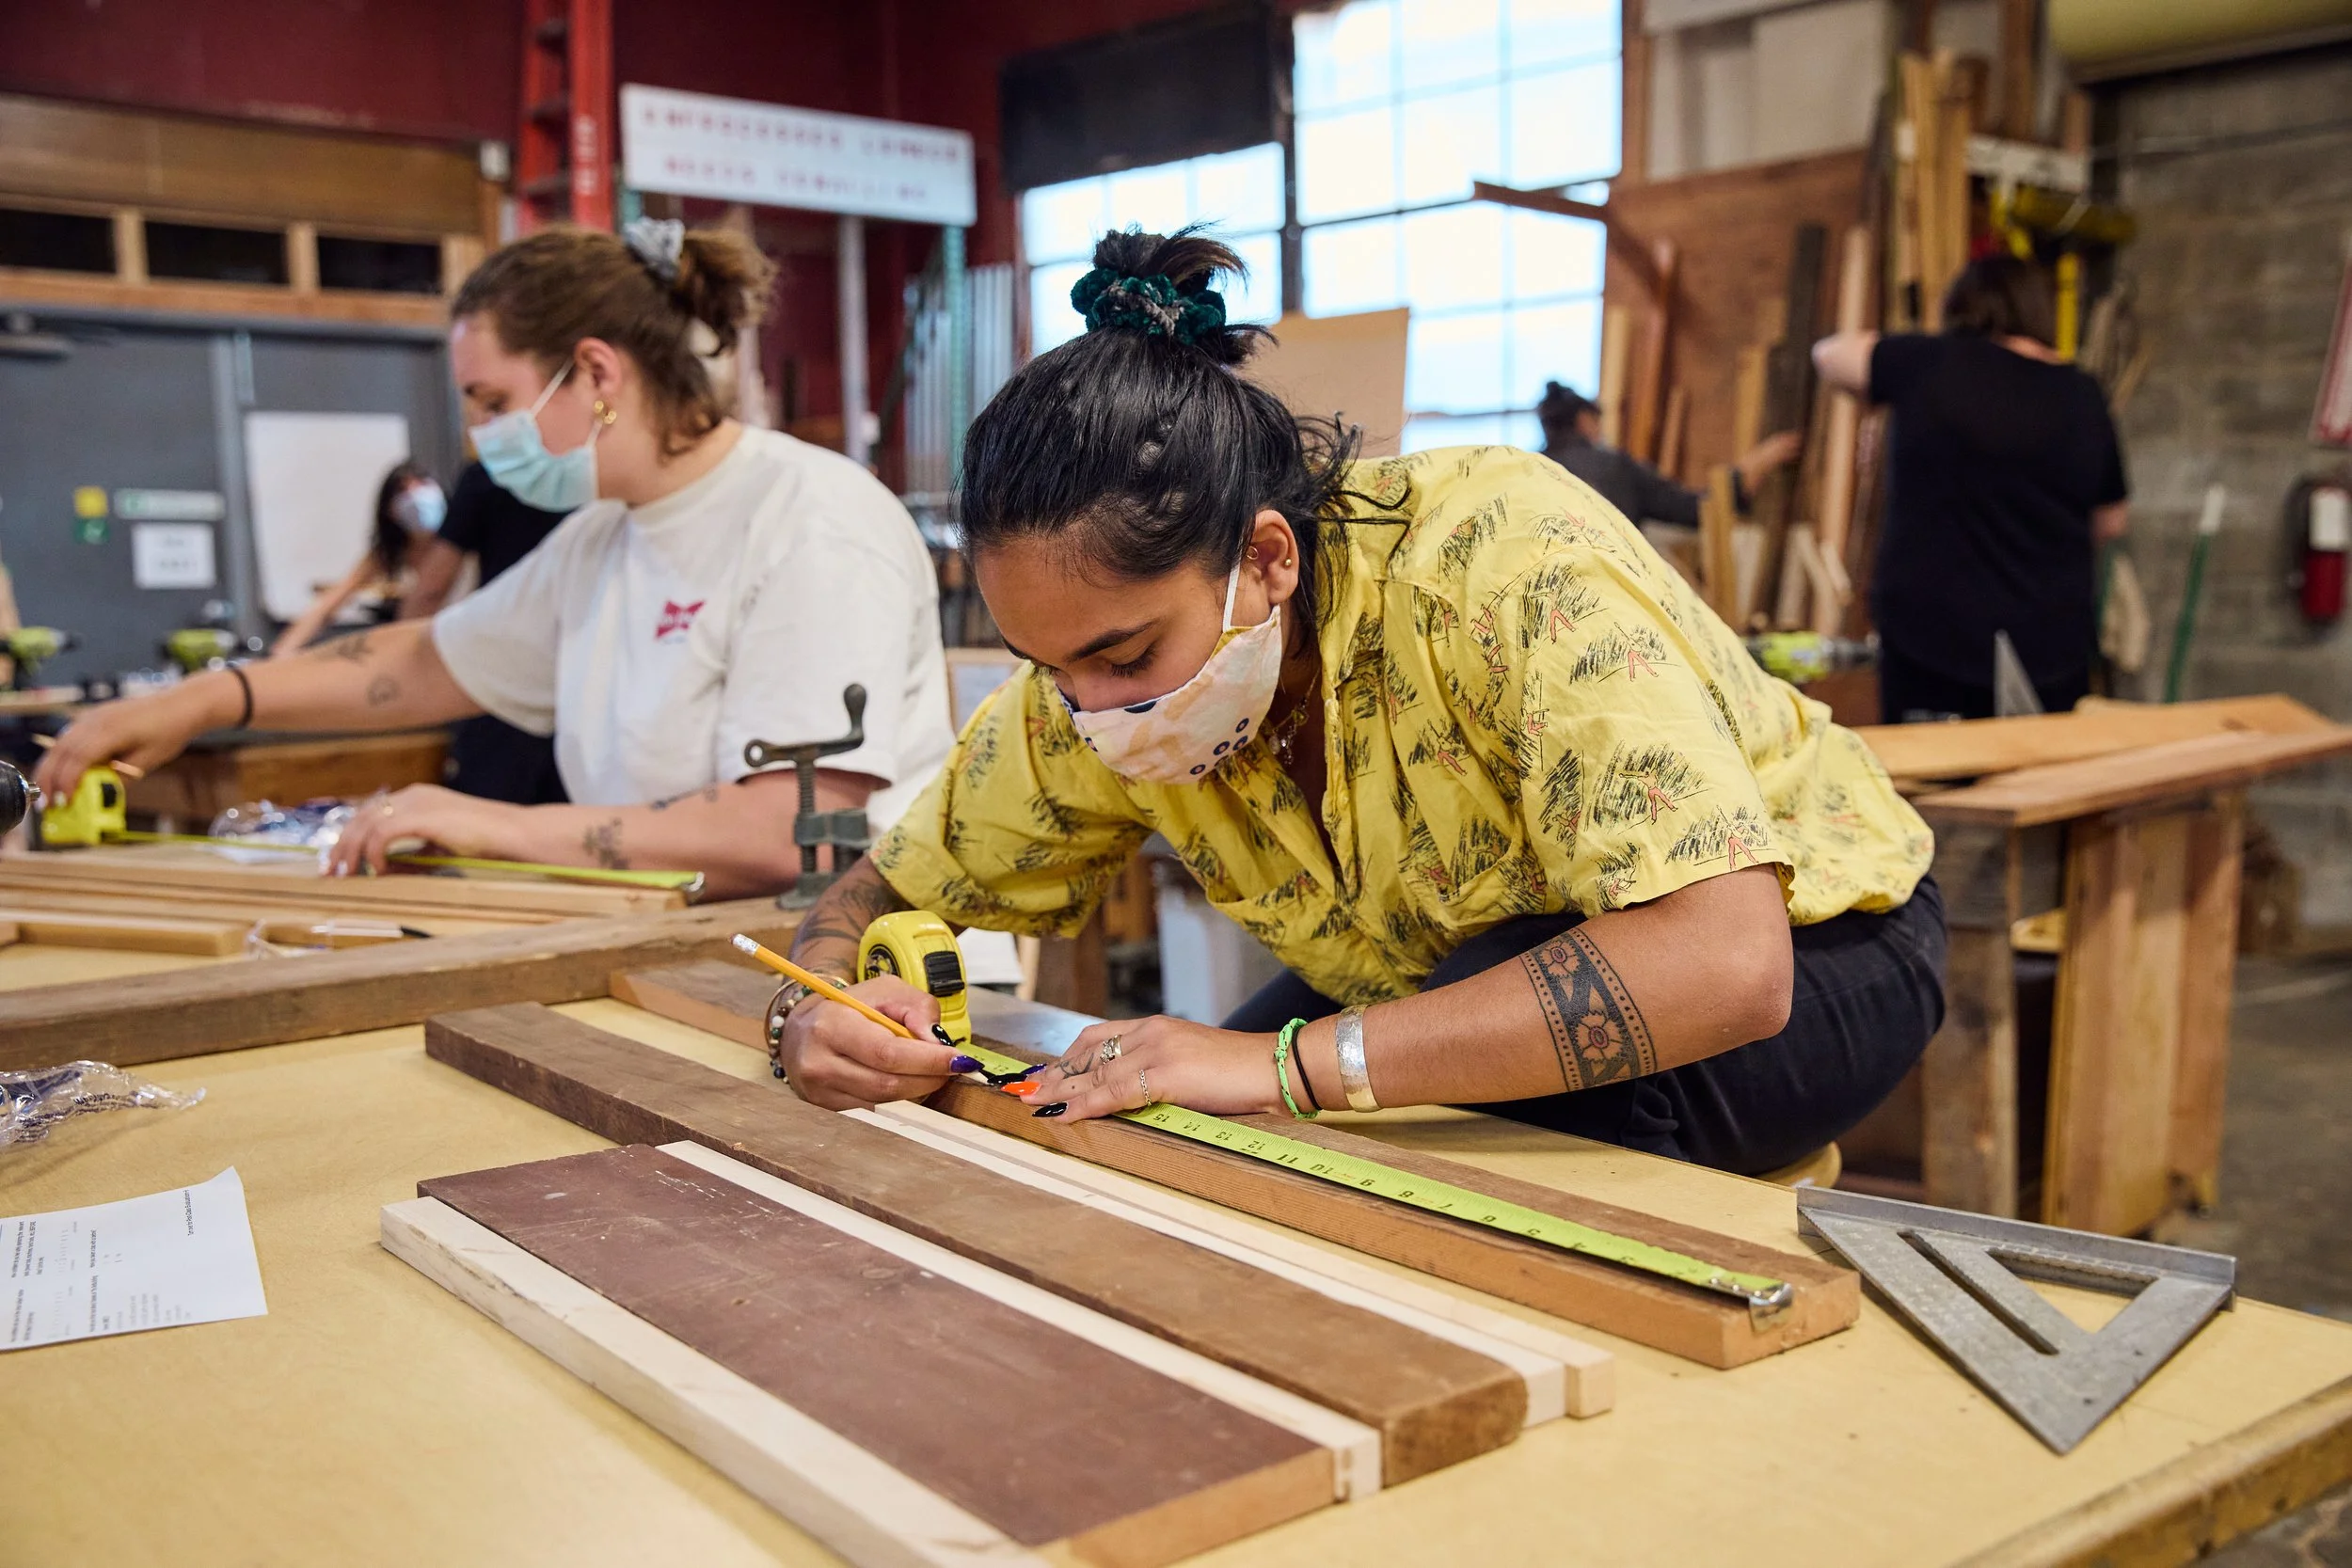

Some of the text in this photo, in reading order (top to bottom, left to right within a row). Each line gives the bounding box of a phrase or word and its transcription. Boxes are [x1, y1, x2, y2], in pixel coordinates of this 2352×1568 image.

[1153, 1113, 1169, 1122] 15
[1184, 1121, 1200, 1132] 14
[1216, 1131, 1232, 1141] 13
[1248, 1140, 1265, 1150] 12
[1277, 1154, 1298, 1164] 11
[1310, 1164, 1334, 1174] 10
[1359, 1179, 1375, 1187] 9
